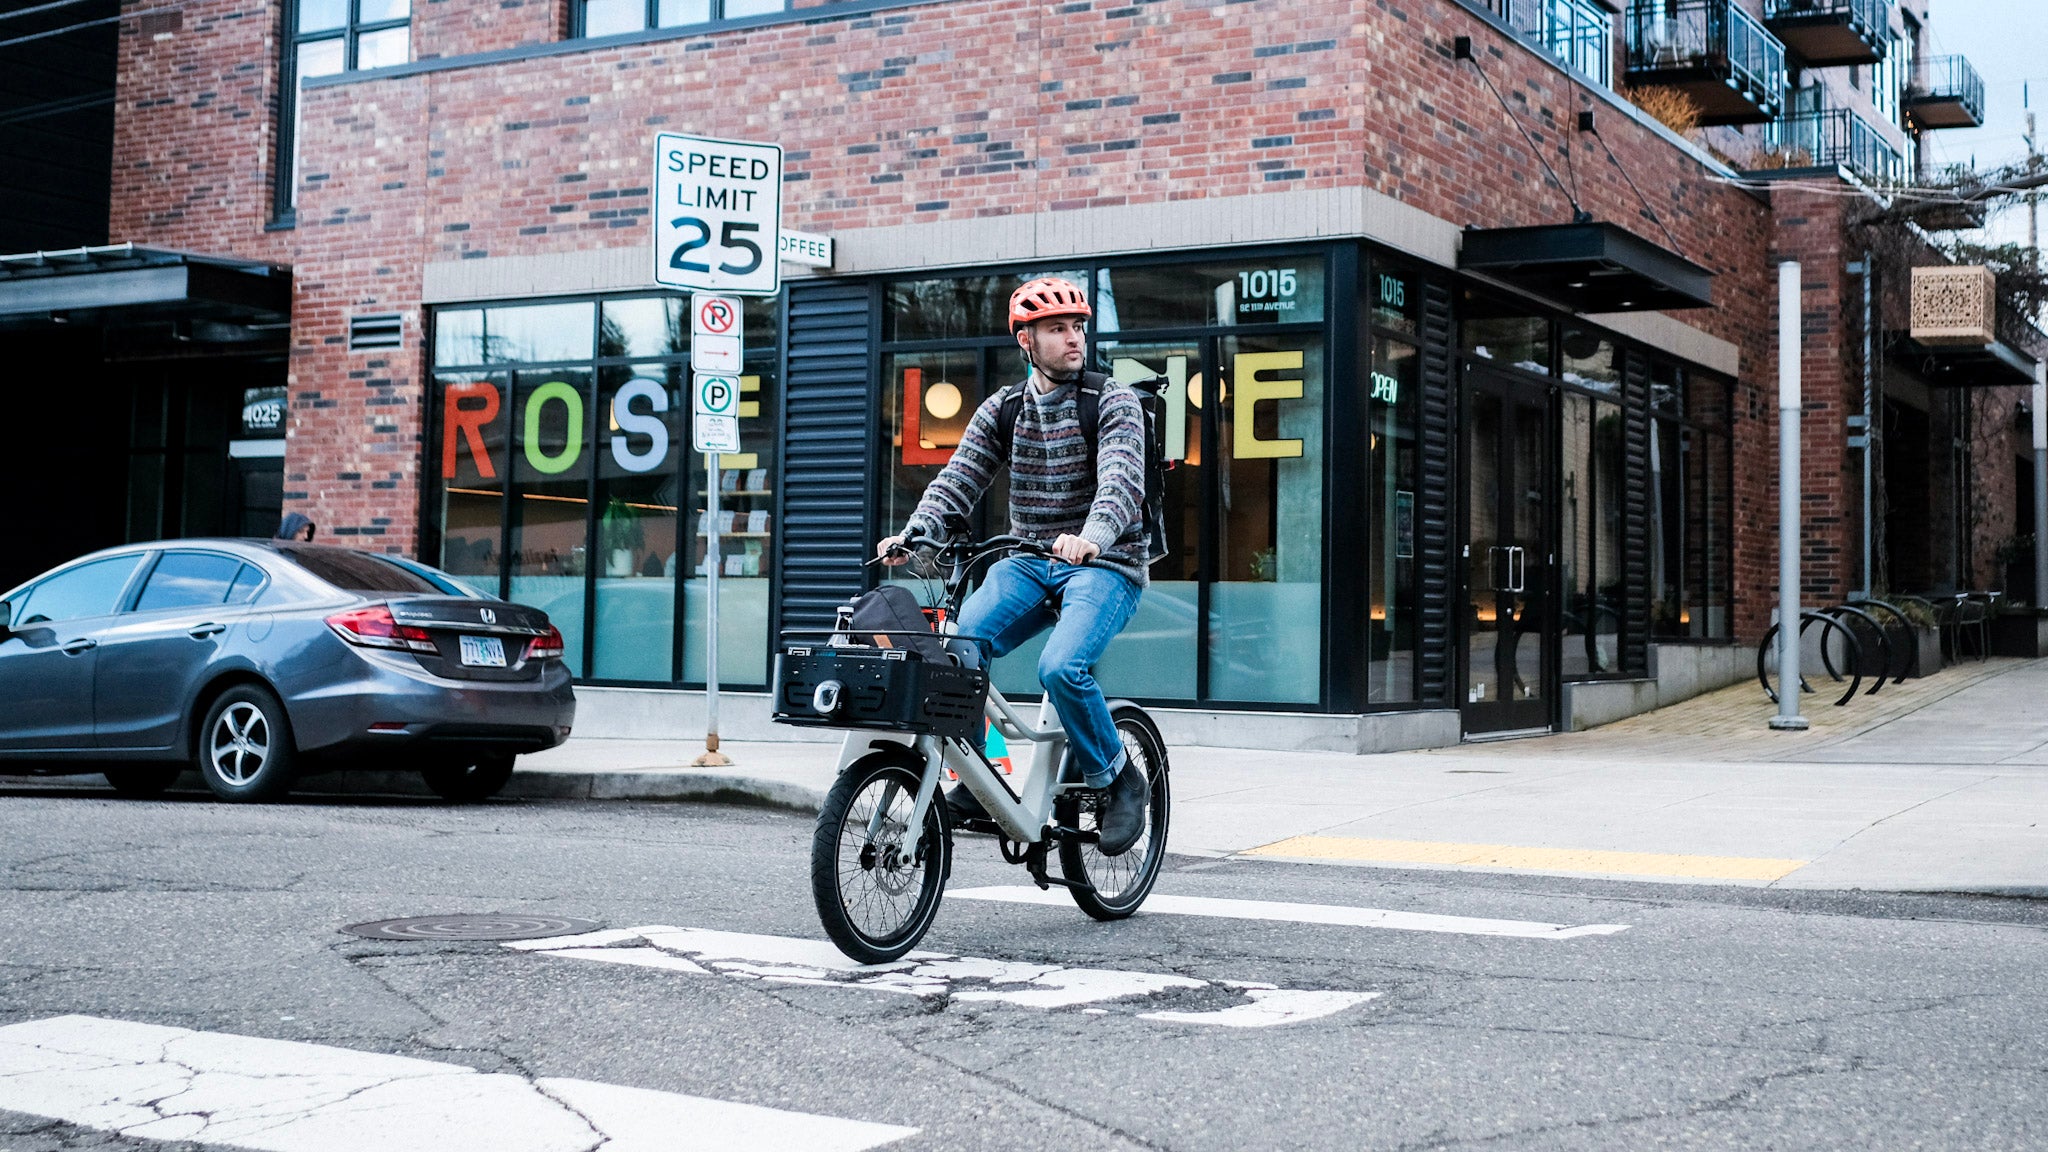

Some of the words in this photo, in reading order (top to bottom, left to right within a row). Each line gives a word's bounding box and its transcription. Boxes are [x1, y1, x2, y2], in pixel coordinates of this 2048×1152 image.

[668, 150, 769, 180] SPEED
[677, 183, 758, 212] LIMIT
[669, 216, 763, 276] 25
[780, 236, 826, 258] OFFEE
[1238, 268, 1297, 299] 1015
[1379, 273, 1405, 307] 1015
[711, 385, 726, 406] P
[1370, 371, 1398, 404] OPEN
[246, 404, 281, 423] 1025
